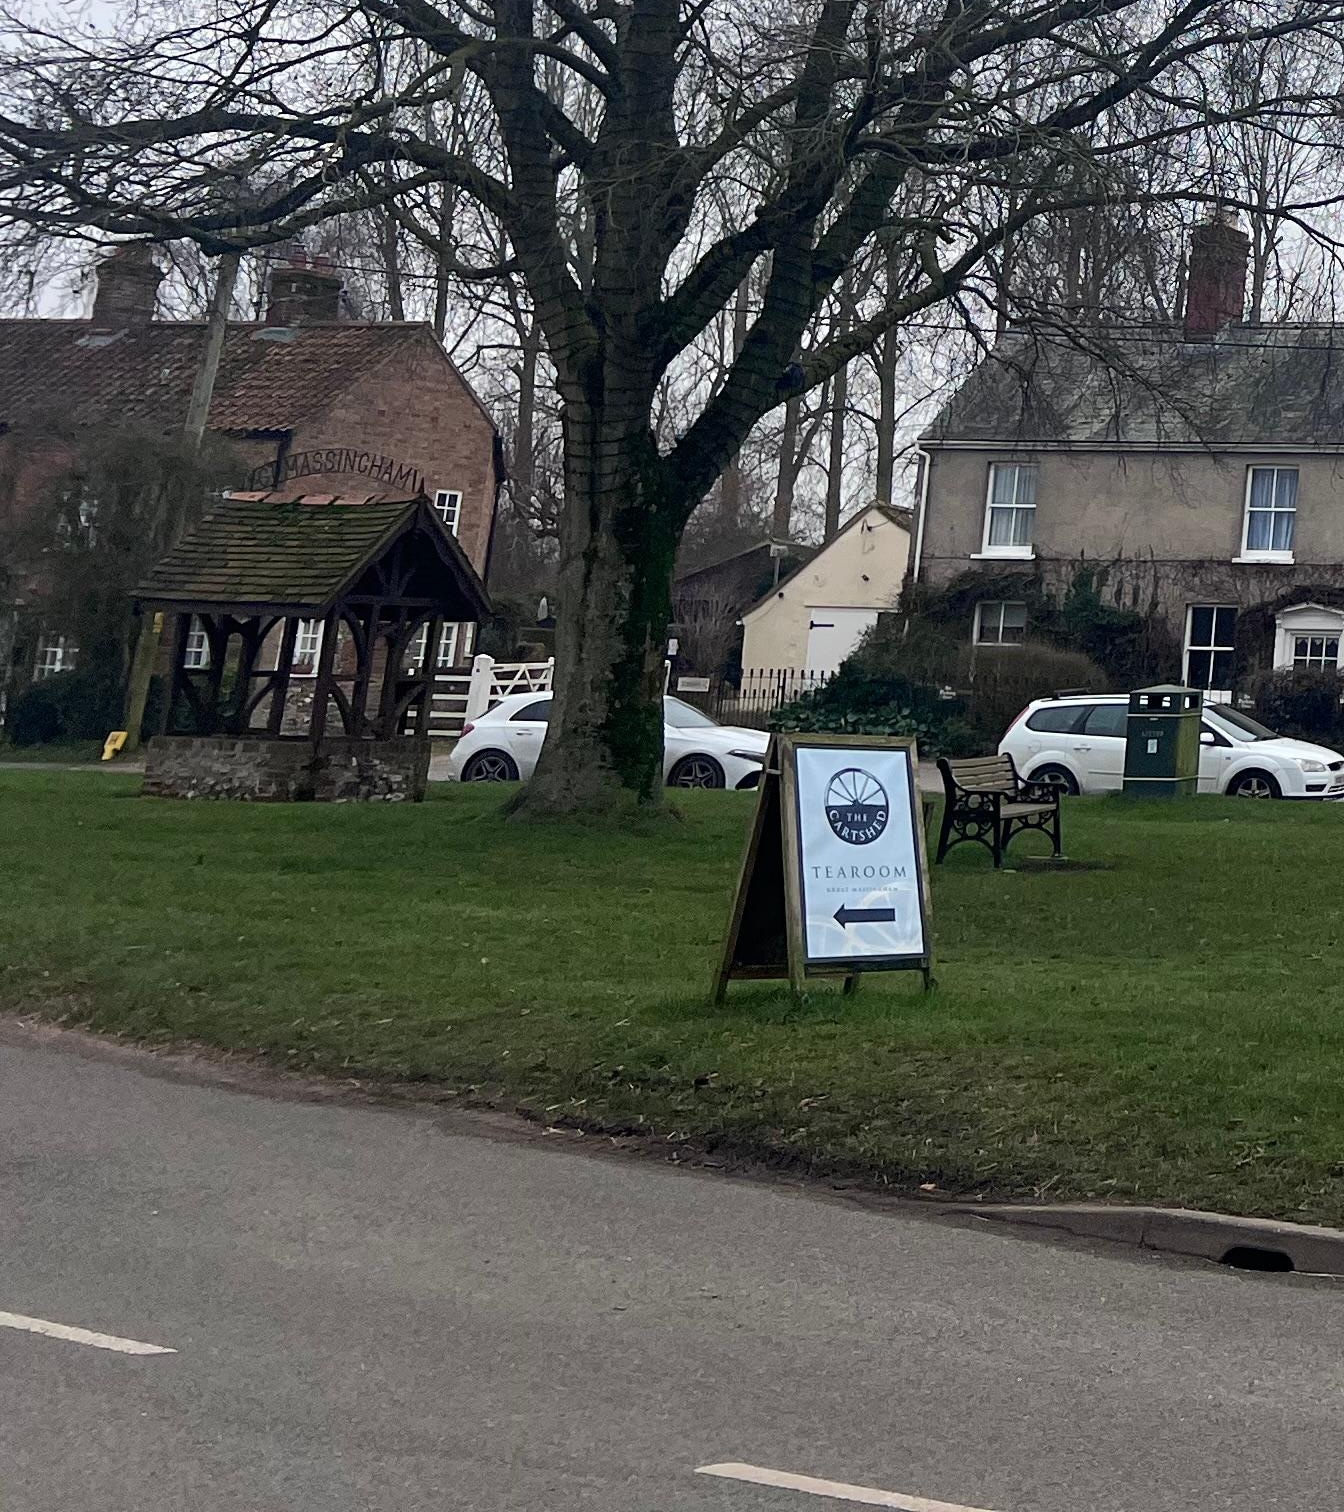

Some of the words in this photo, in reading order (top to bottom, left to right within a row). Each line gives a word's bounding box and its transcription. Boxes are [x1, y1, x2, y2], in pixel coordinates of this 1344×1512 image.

[284, 450, 415, 490] MASSINGHAM
[829, 809, 887, 841] CARTSHED
[846, 812, 868, 822] THE
[811, 865, 907, 879] TEAROOM
